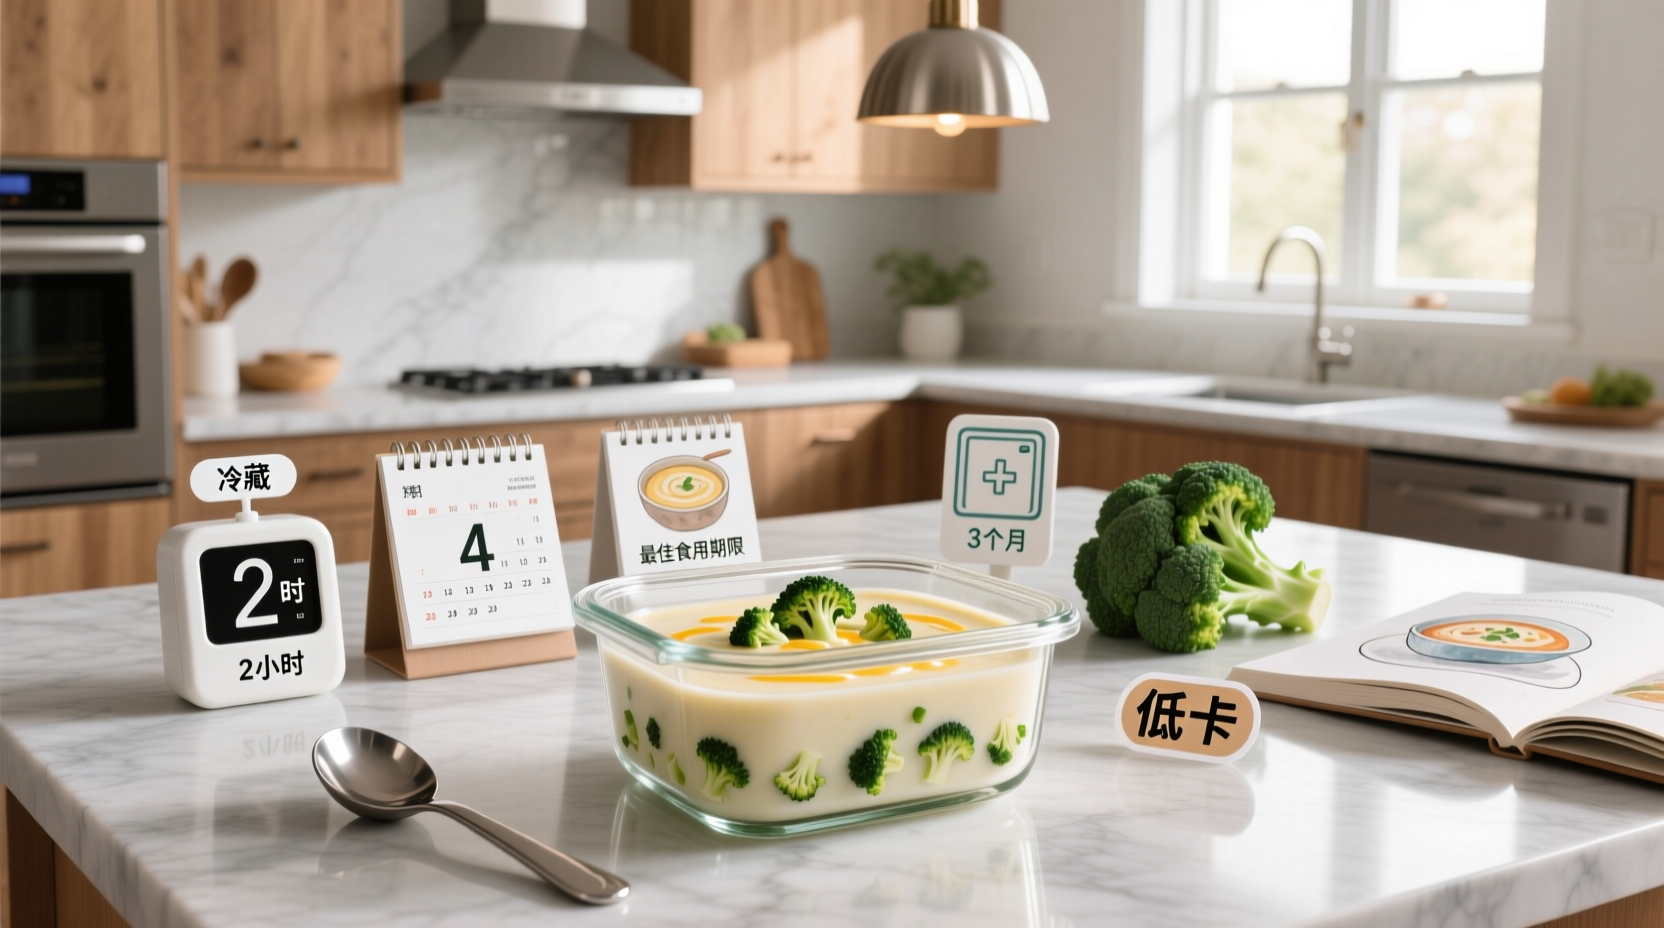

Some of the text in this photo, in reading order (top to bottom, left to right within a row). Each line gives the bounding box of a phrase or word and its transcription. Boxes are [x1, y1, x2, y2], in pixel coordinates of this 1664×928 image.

[216, 462, 271, 493] 冷藏
[460, 522, 495, 572] 4
[967, 527, 1025, 553] 3个月
[238, 650, 305, 682] 2小时
[1136, 688, 1238, 746] 低卡
